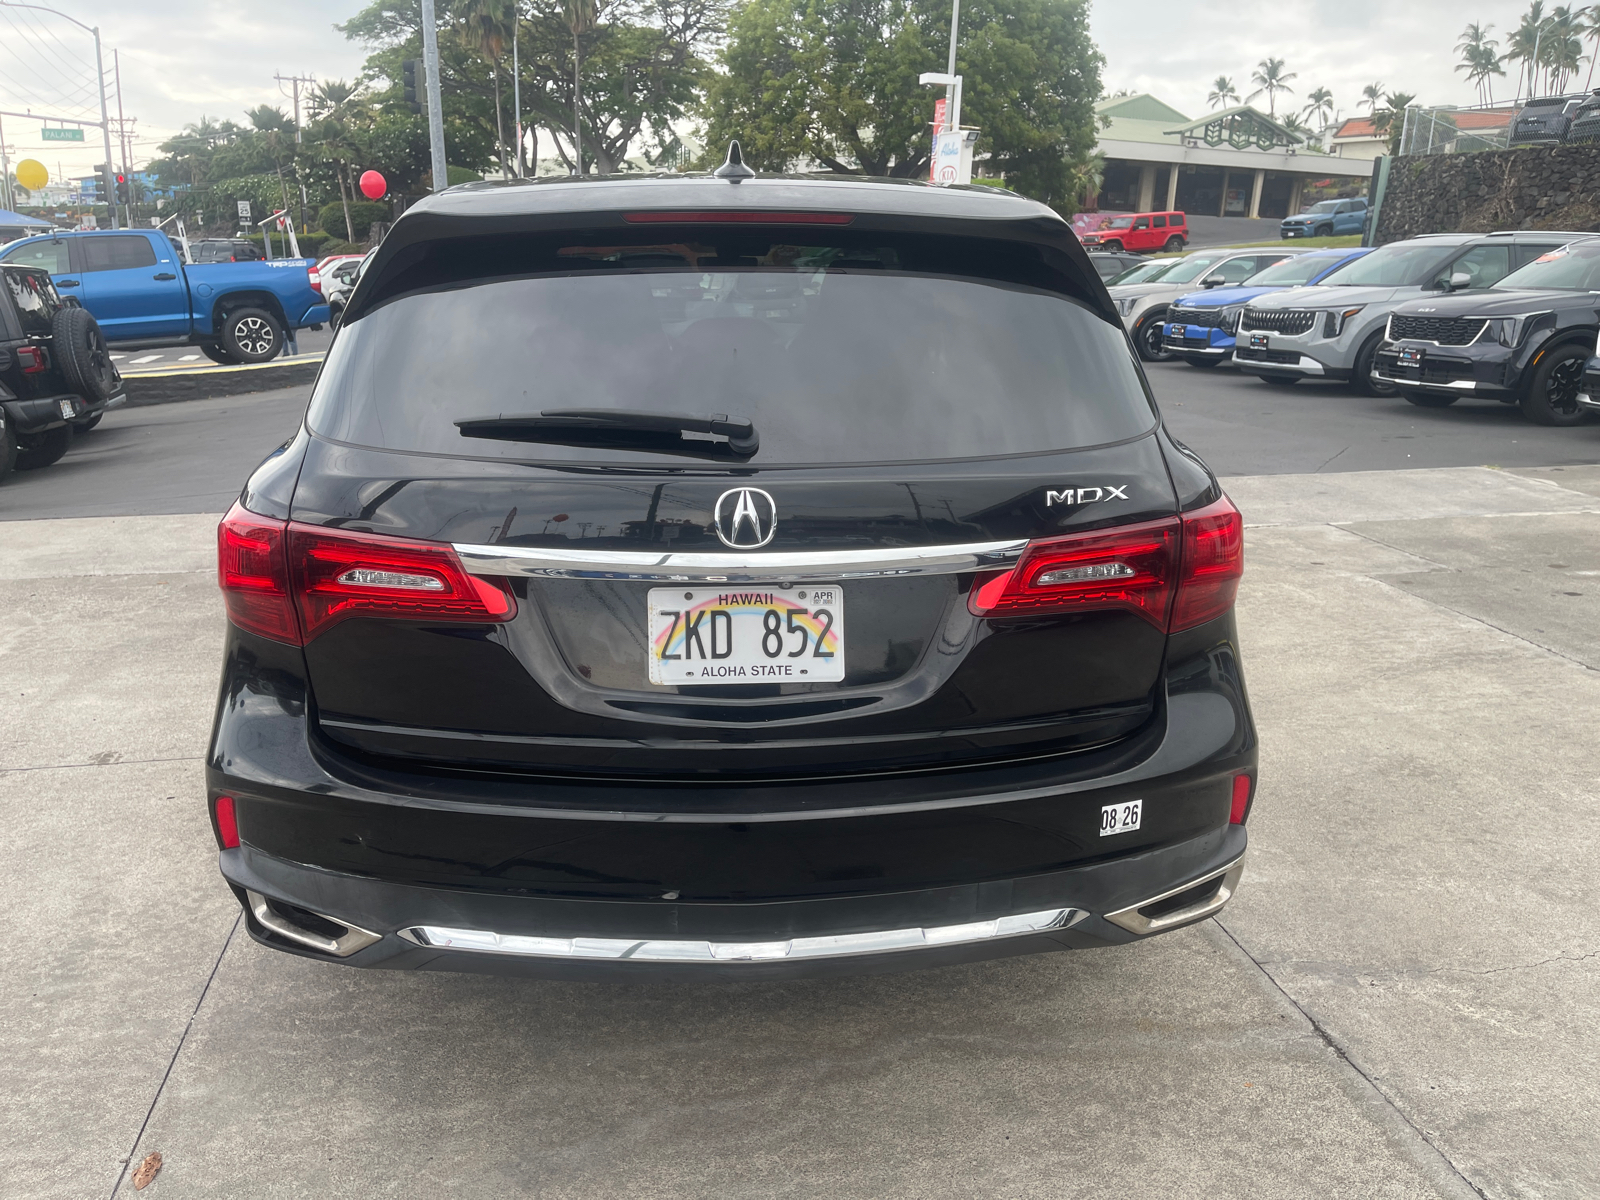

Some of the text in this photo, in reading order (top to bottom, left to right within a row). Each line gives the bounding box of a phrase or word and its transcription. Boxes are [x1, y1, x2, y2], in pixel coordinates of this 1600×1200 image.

[45, 131, 73, 139] PALANI
[940, 142, 959, 156] Aloha
[941, 170, 955, 181] KIA
[1046, 484, 1130, 507] MDX
[718, 593, 774, 606] HAWAII
[813, 591, 833, 600] APR
[660, 608, 835, 660] ZKD 852
[701, 665, 793, 677] ALOHA STATE
[1101, 808, 1118, 831] 08
[1122, 803, 1139, 827] 26
